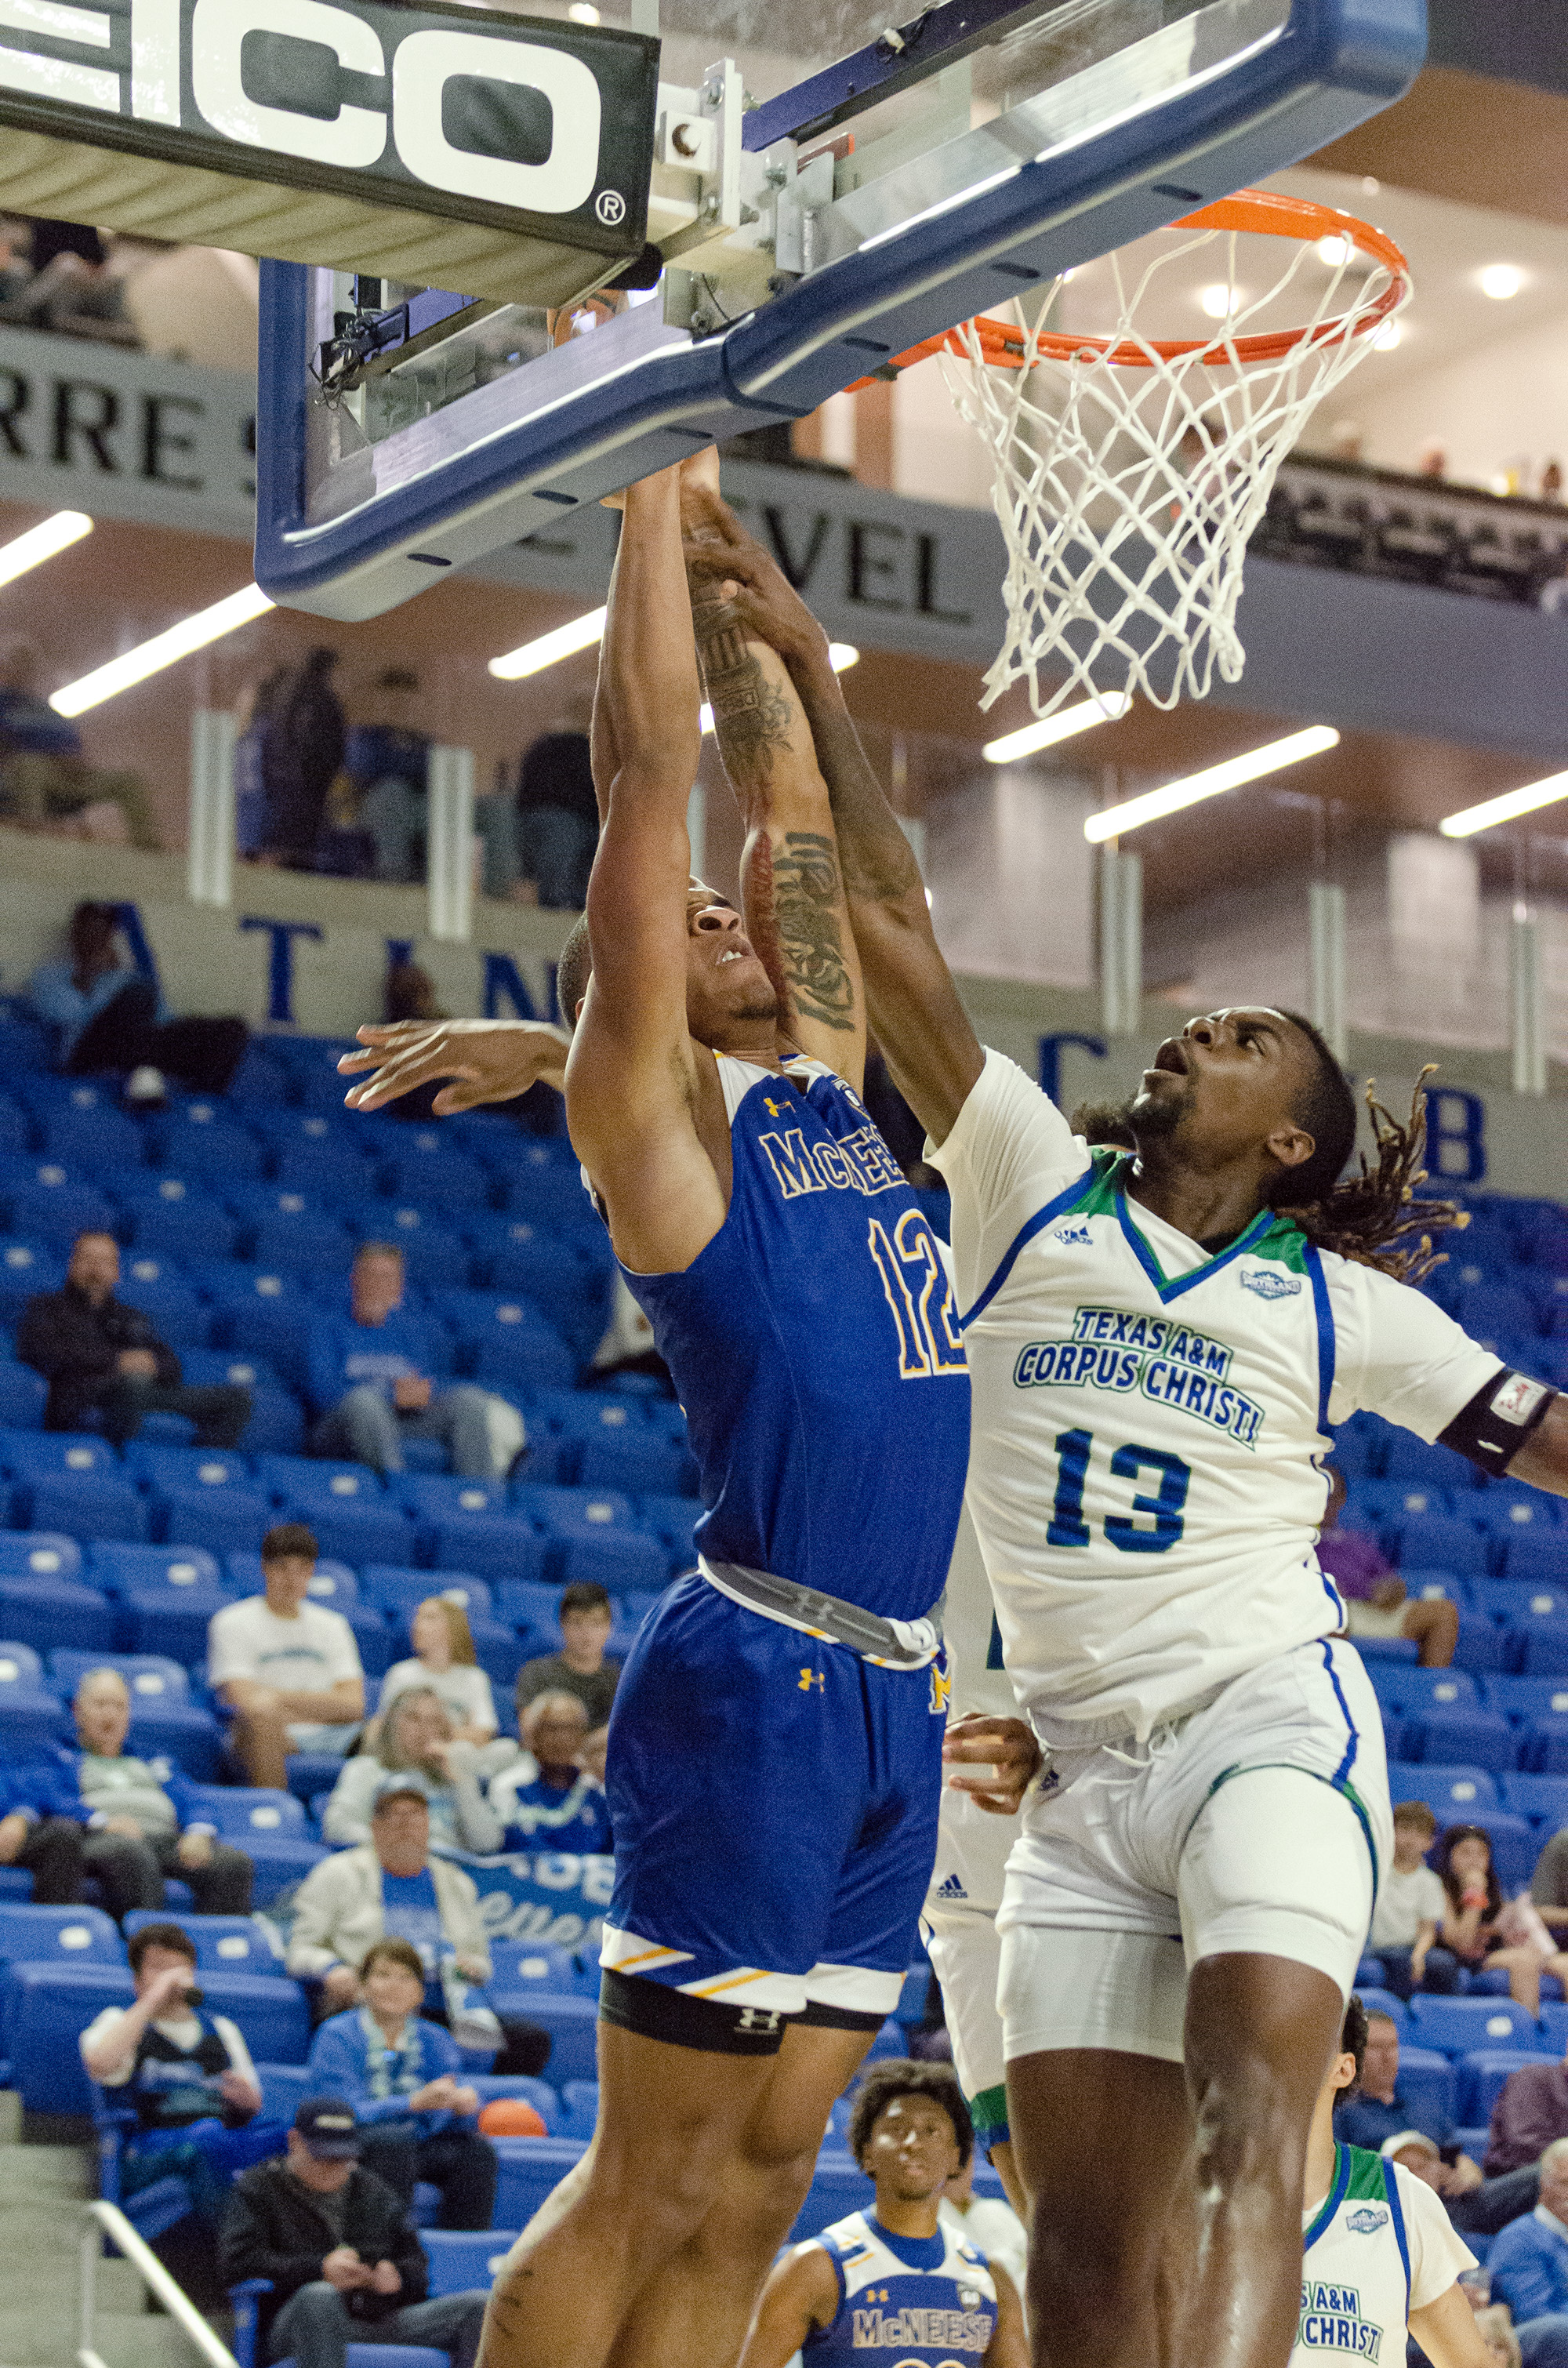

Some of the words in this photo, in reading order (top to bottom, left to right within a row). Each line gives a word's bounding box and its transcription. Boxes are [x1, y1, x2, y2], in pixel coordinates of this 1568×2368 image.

[868, 1208, 971, 1379] 12
[1076, 1309, 1167, 1354] TEXAS
[1169, 1327, 1230, 1377] A&M
[1017, 1343, 1140, 1388] CORPUS
[1145, 1360, 1261, 1443] CHRISTI
[1046, 1428, 1191, 1553] 13
[852, 2307, 993, 2353] McNEESE
[1315, 2286, 1358, 2315] A&M
